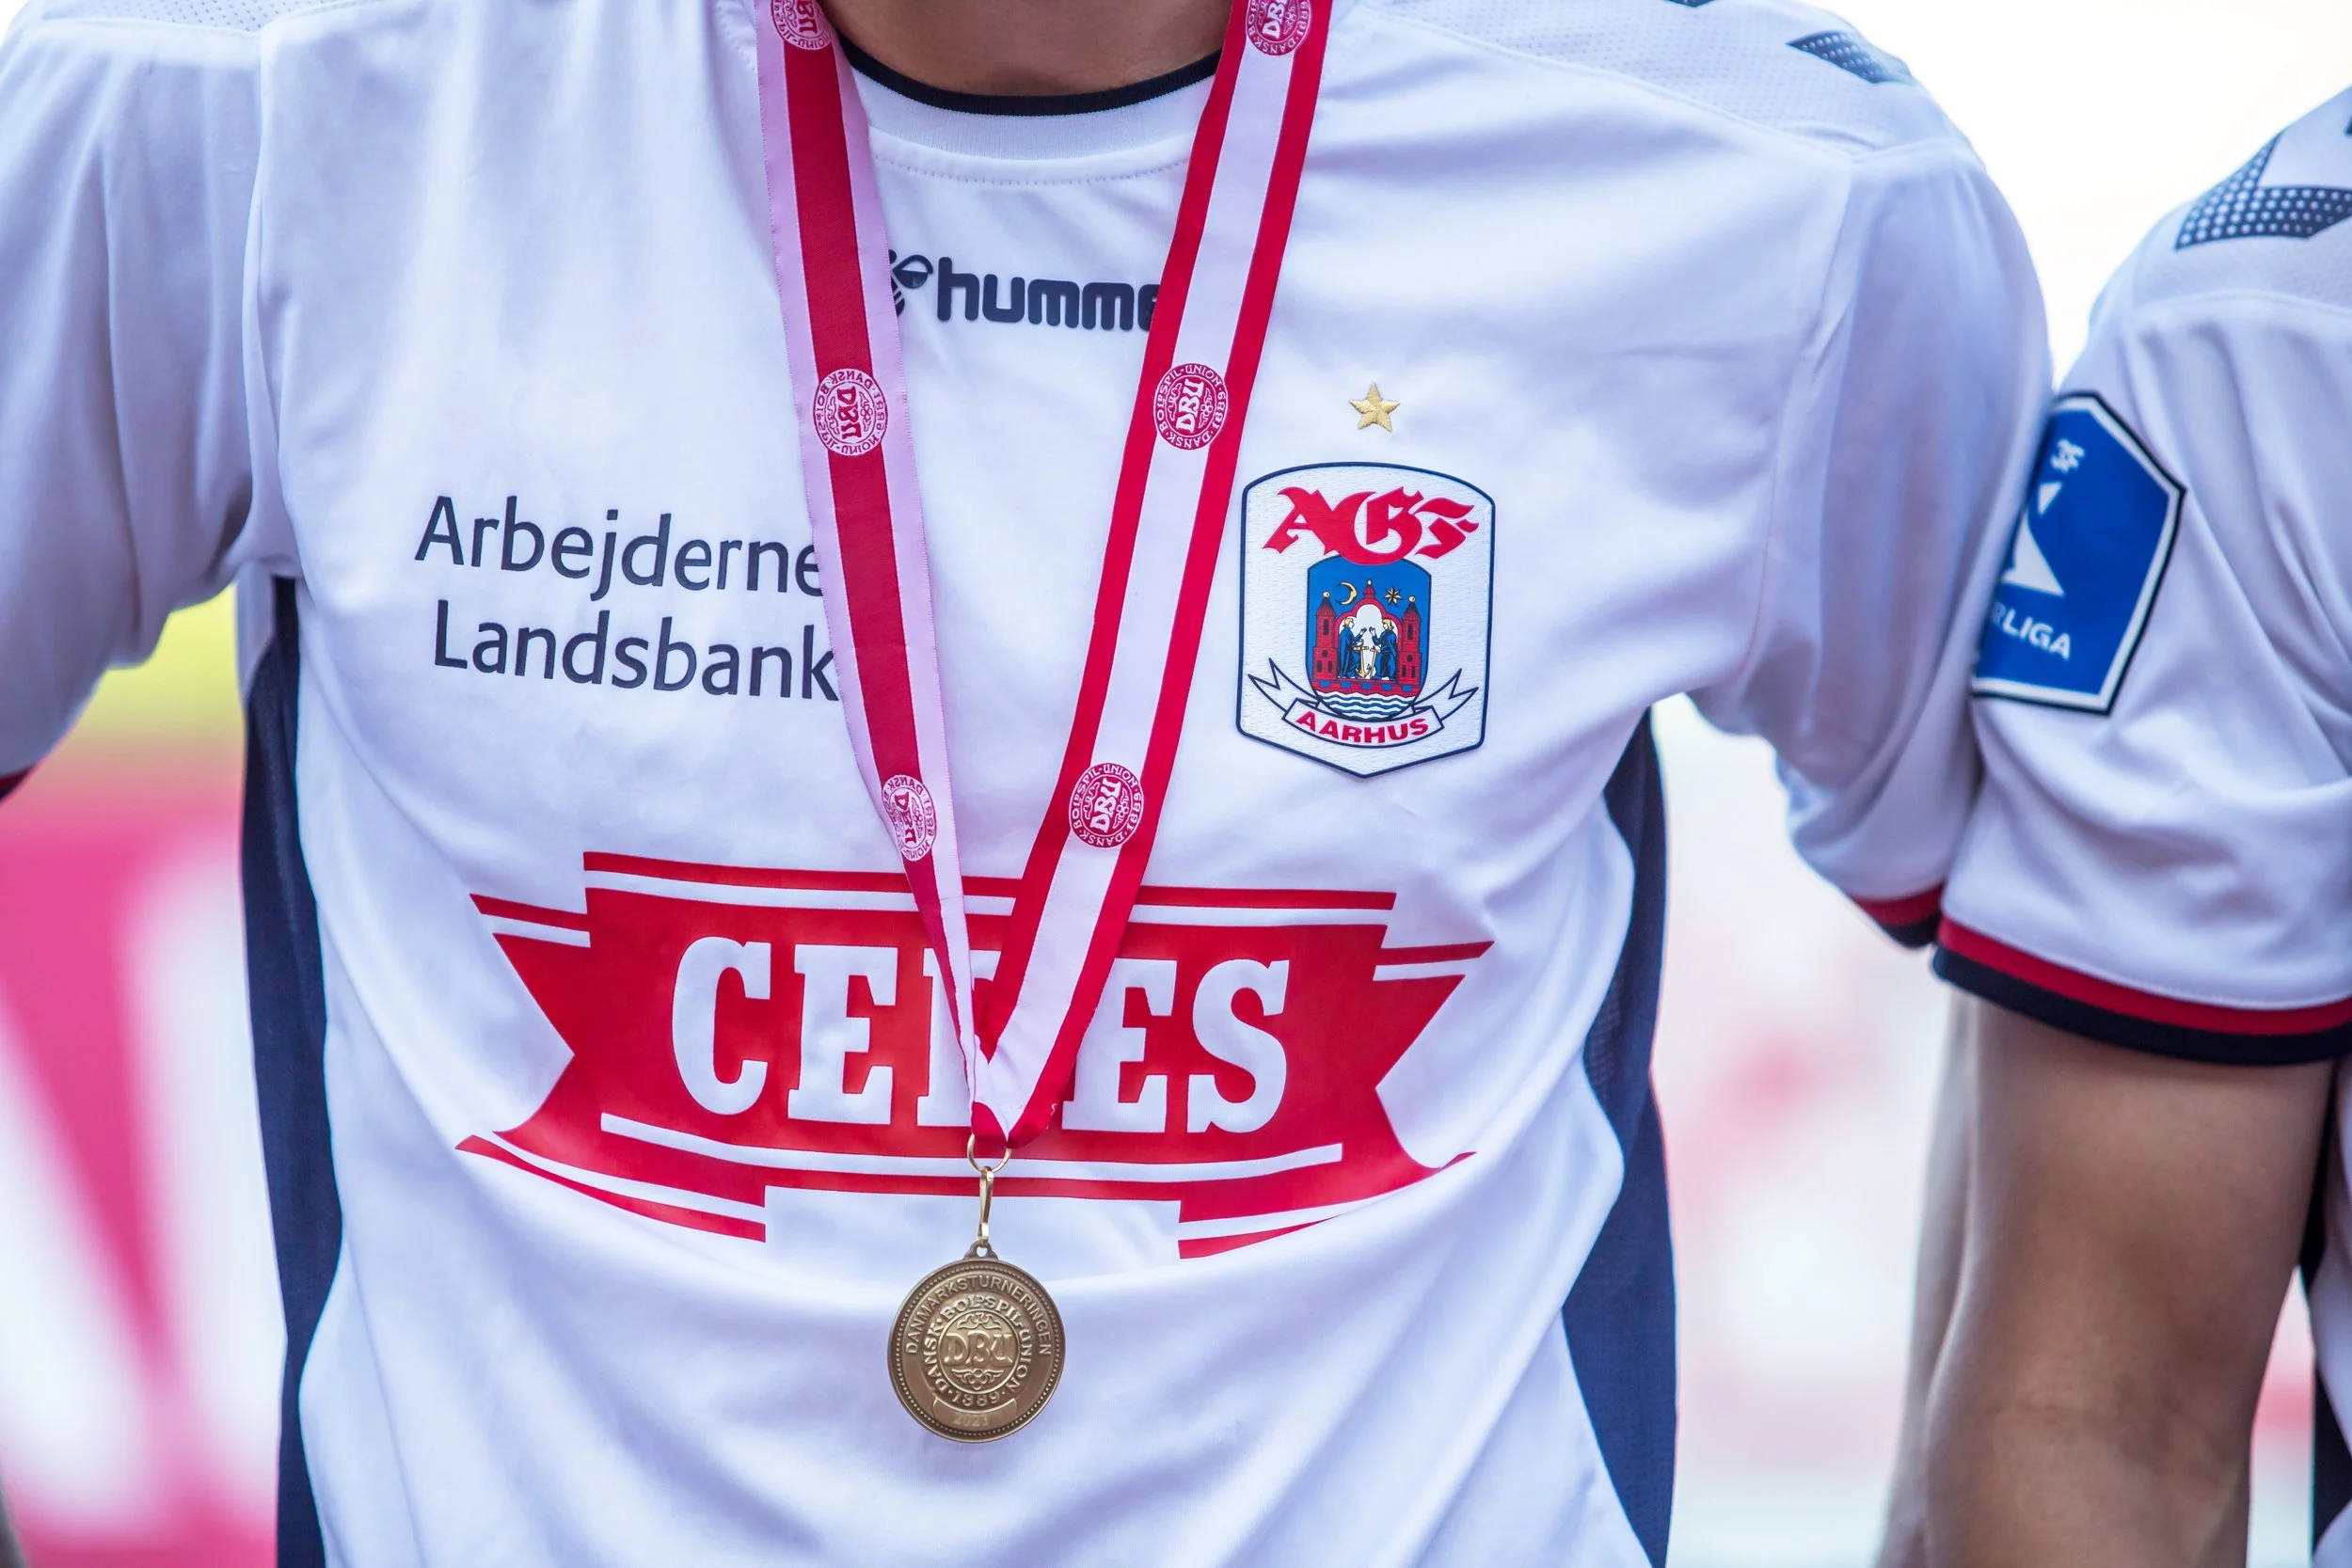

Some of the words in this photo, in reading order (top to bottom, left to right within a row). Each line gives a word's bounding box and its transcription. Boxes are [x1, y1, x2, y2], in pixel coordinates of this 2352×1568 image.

[1262, 0, 1288, 39] DB
[1176, 378, 1204, 433] DBU
[1262, 485, 1480, 566] AGF
[435, 598, 839, 702] Landsbank
[1295, 710, 1429, 744] AARHUS
[1089, 778, 1121, 832] DBU
[906, 1275, 1052, 1356] DANMARKSTURNERINGEN
[944, 1329, 1013, 1364] DBU
